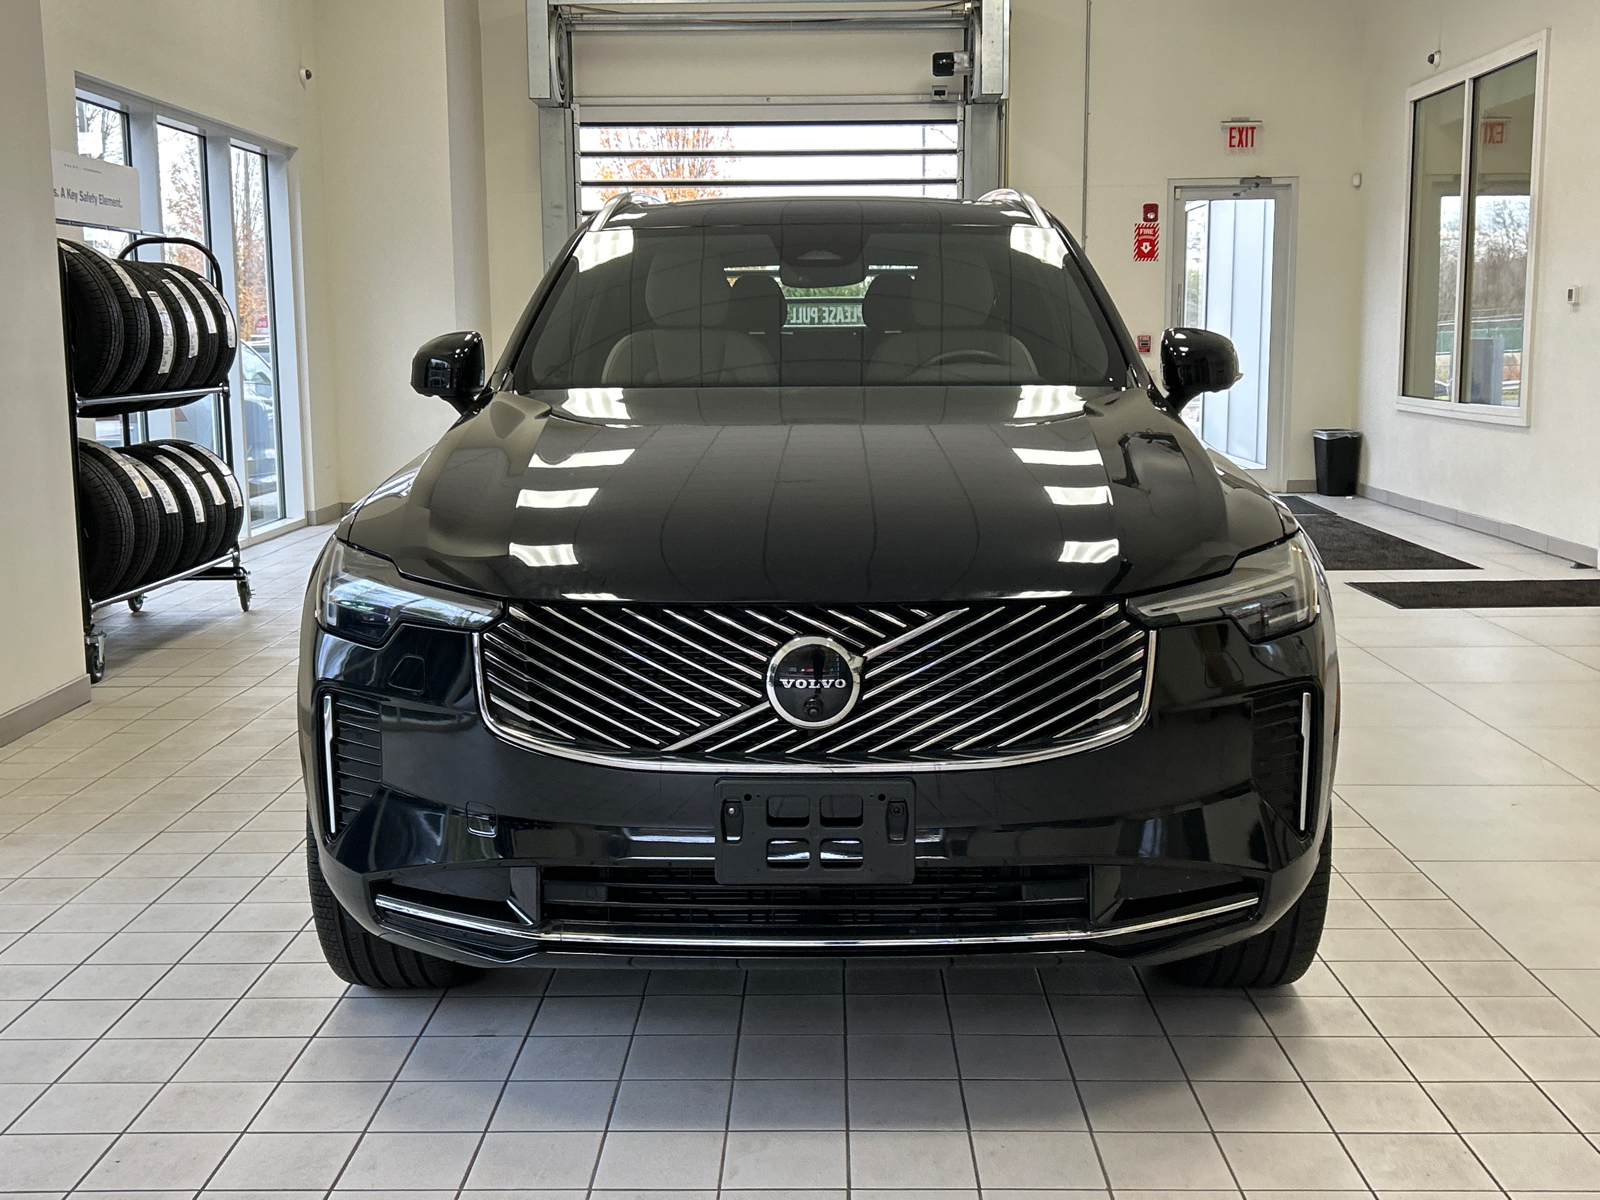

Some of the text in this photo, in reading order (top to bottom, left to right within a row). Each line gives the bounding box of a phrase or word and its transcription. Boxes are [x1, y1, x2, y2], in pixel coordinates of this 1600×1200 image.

[1229, 126, 1256, 148] EXIT
[60, 187, 66, 199] A
[66, 188, 78, 203] Key
[79, 190, 98, 206] Safety
[779, 678, 847, 689] VOLVO
